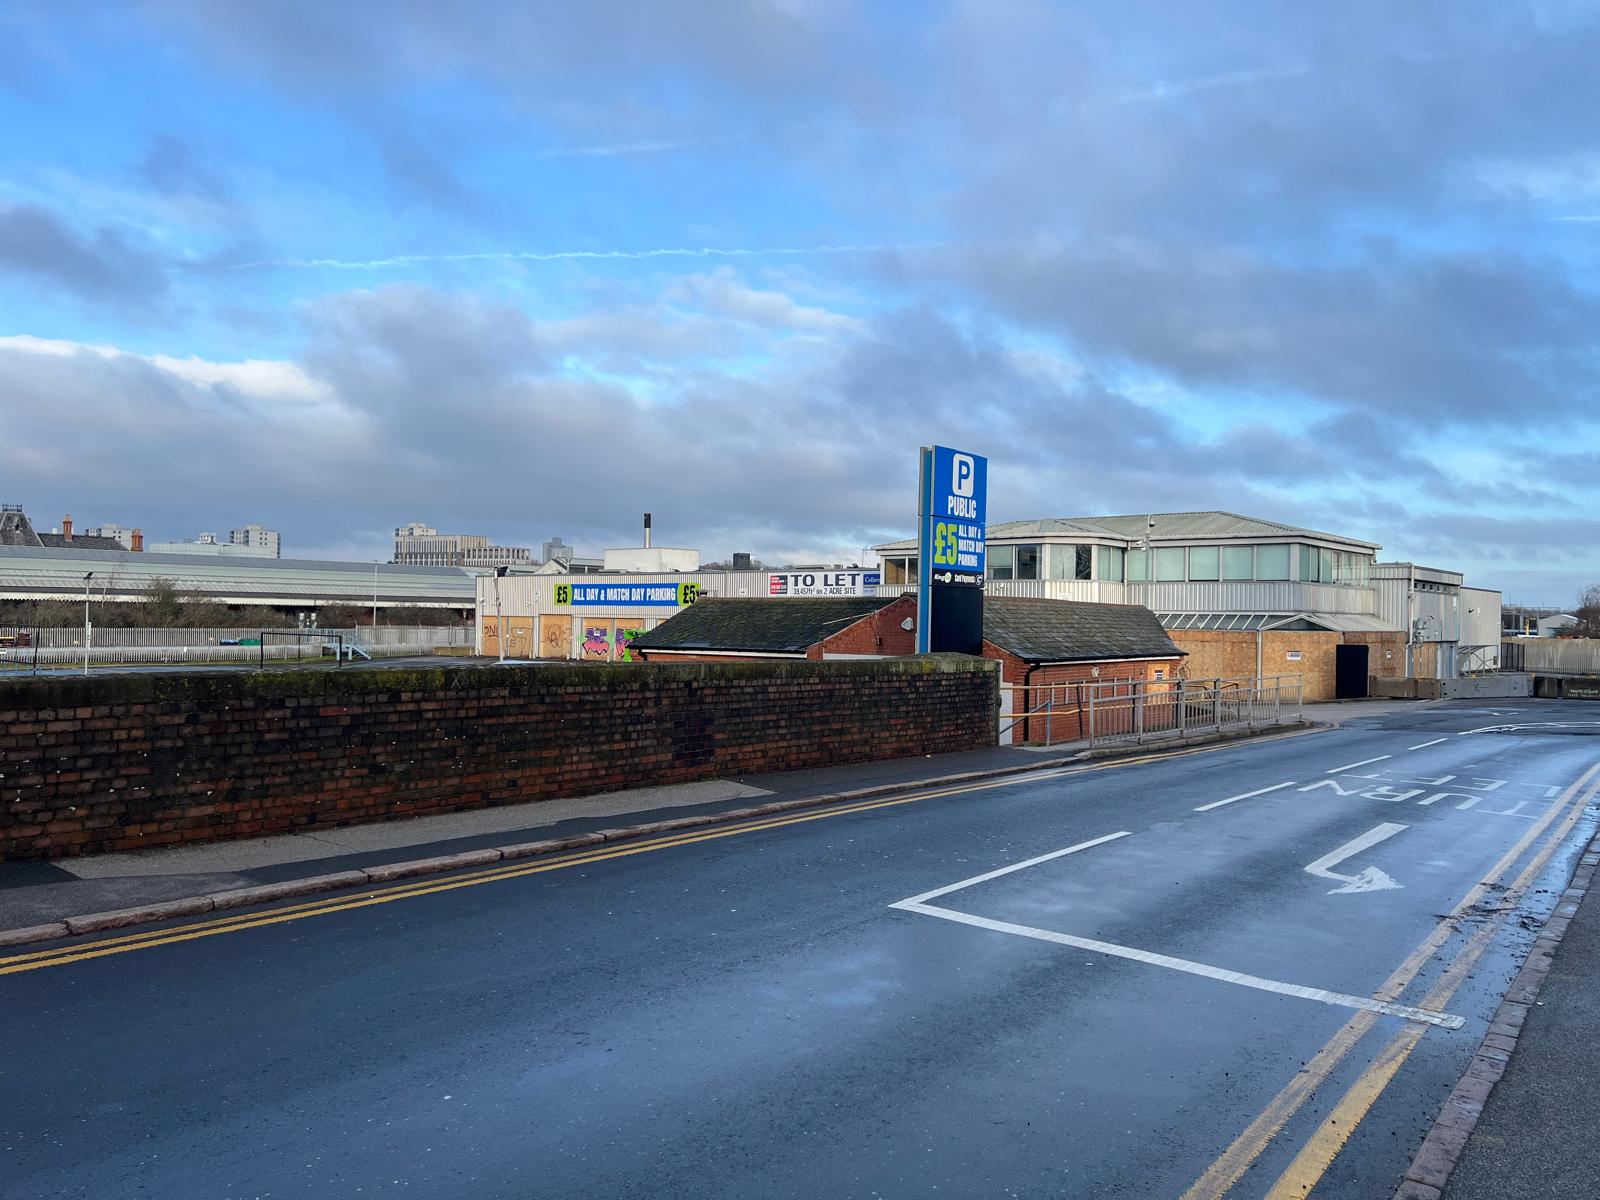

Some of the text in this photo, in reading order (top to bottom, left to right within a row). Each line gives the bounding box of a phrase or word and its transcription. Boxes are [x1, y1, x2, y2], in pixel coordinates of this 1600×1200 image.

[958, 459, 970, 490] P
[948, 496, 976, 519] PUBLIC
[958, 524, 981, 539] ALL DAY &
[934, 522, 958, 565] £5
[958, 538, 984, 554] MATCH DAY
[958, 553, 978, 567] PARKING
[790, 574, 815, 587] TO
[823, 574, 860, 587] LET
[556, 585, 568, 604] £5
[573, 587, 676, 601] ALL DAY & MATCH DAY PARKING
[682, 584, 696, 604] £5
[823, 587, 828, 595] 2
[829, 587, 843, 595] ACRE
[844, 587, 856, 595] SITE
[1296, 780, 1538, 819] TURN
